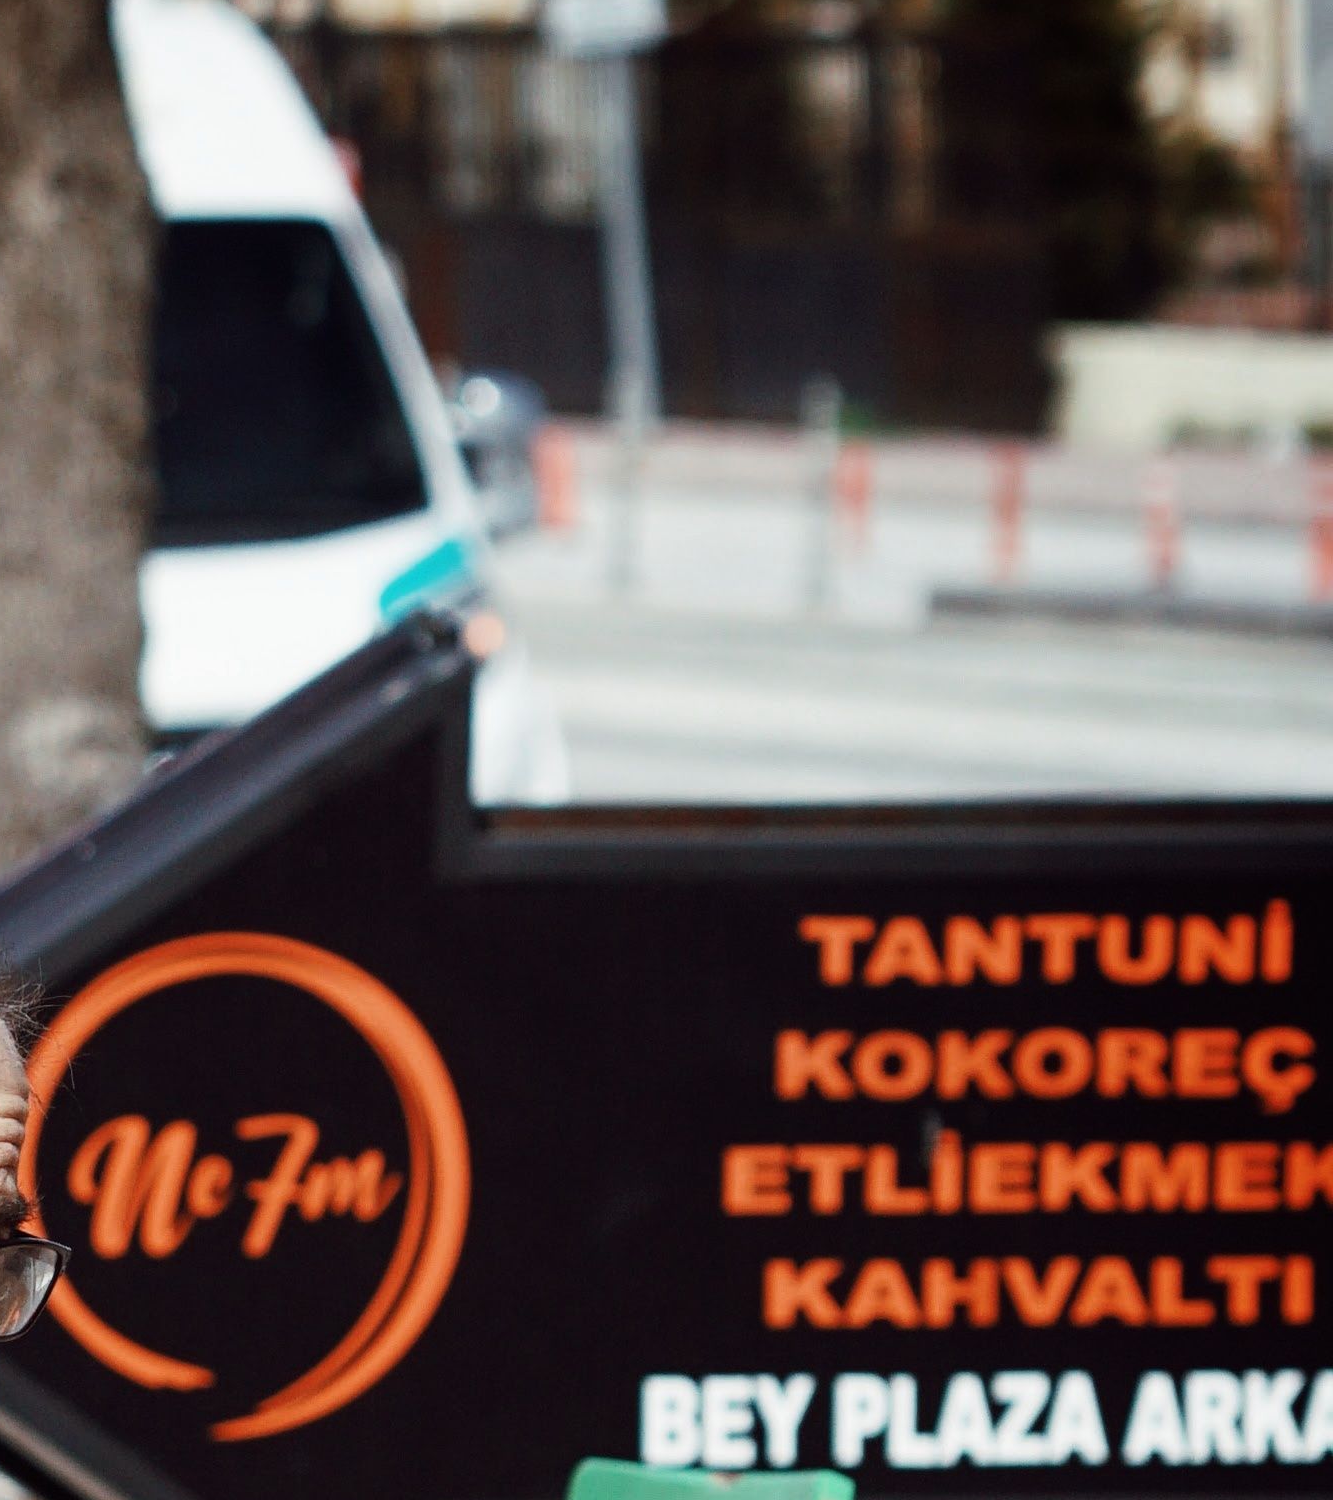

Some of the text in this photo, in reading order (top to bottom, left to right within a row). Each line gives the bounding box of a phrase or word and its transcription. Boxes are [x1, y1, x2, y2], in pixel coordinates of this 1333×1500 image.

[798, 898, 1295, 987] TANTUNİ
[773, 1025, 1317, 1114] KOKOREÇ
[720, 1128, 1333, 1217] ETLİEKMEK
[761, 1254, 1315, 1330] KAHVALTI
[639, 1372, 818, 1467] BEY
[831, 1369, 1110, 1469] PLAZA
